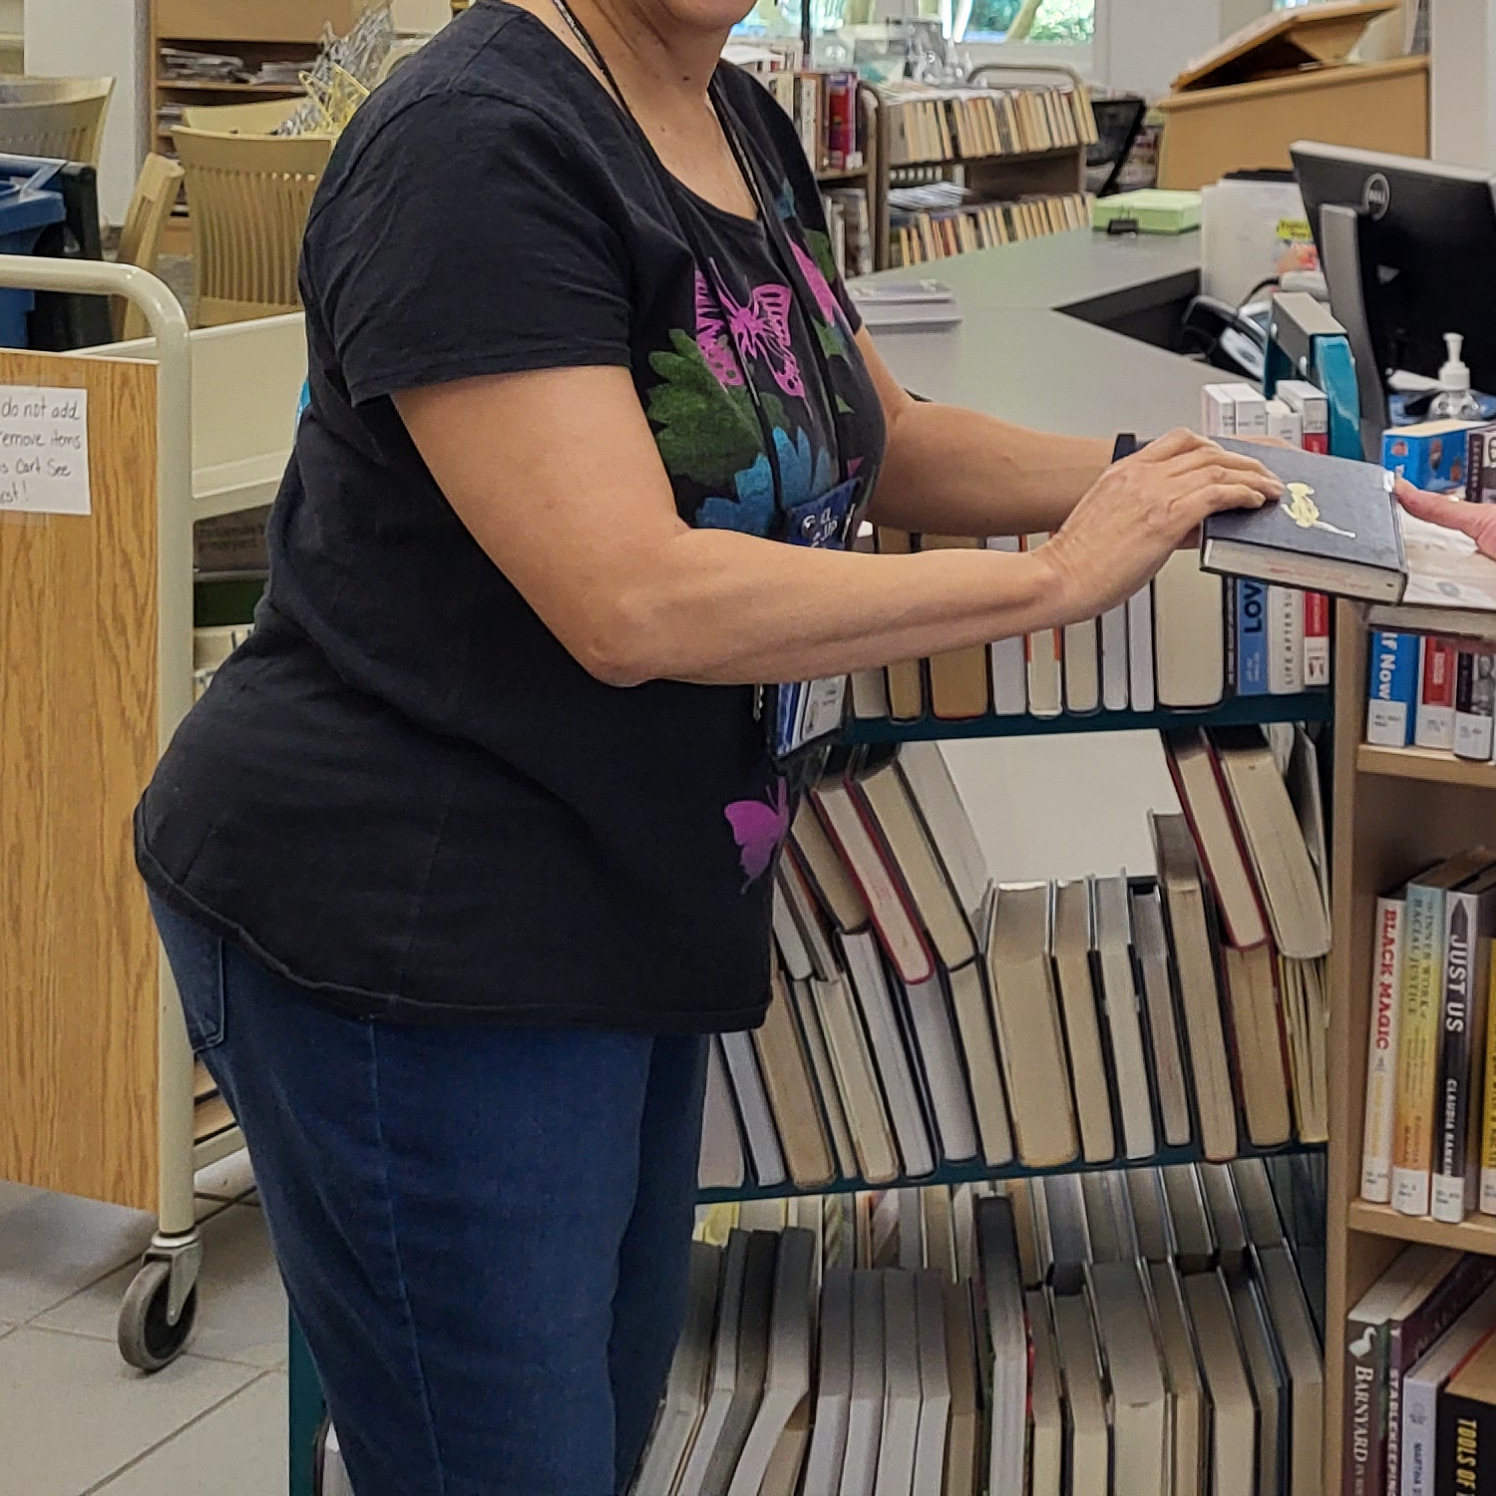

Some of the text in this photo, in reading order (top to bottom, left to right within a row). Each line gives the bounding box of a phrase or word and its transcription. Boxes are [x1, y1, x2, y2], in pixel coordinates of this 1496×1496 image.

[23, 396, 48, 418] not
[51, 401, 81, 421] add
[50, 429, 82, 450] items
[15, 456, 41, 475] Cart
[47, 458, 72, 477] See
[1380, 653, 1396, 700] Now
[1377, 909, 1397, 1050] BLACK MAGIC
[1447, 934, 1466, 1032] JUST US
[1445, 1078, 1457, 1129] CLAUDIA
[1355, 1365, 1373, 1462] BARNYARD
[1458, 1418, 1477, 1466] TOOLS
[1456, 1467, 1476, 1487] OF
